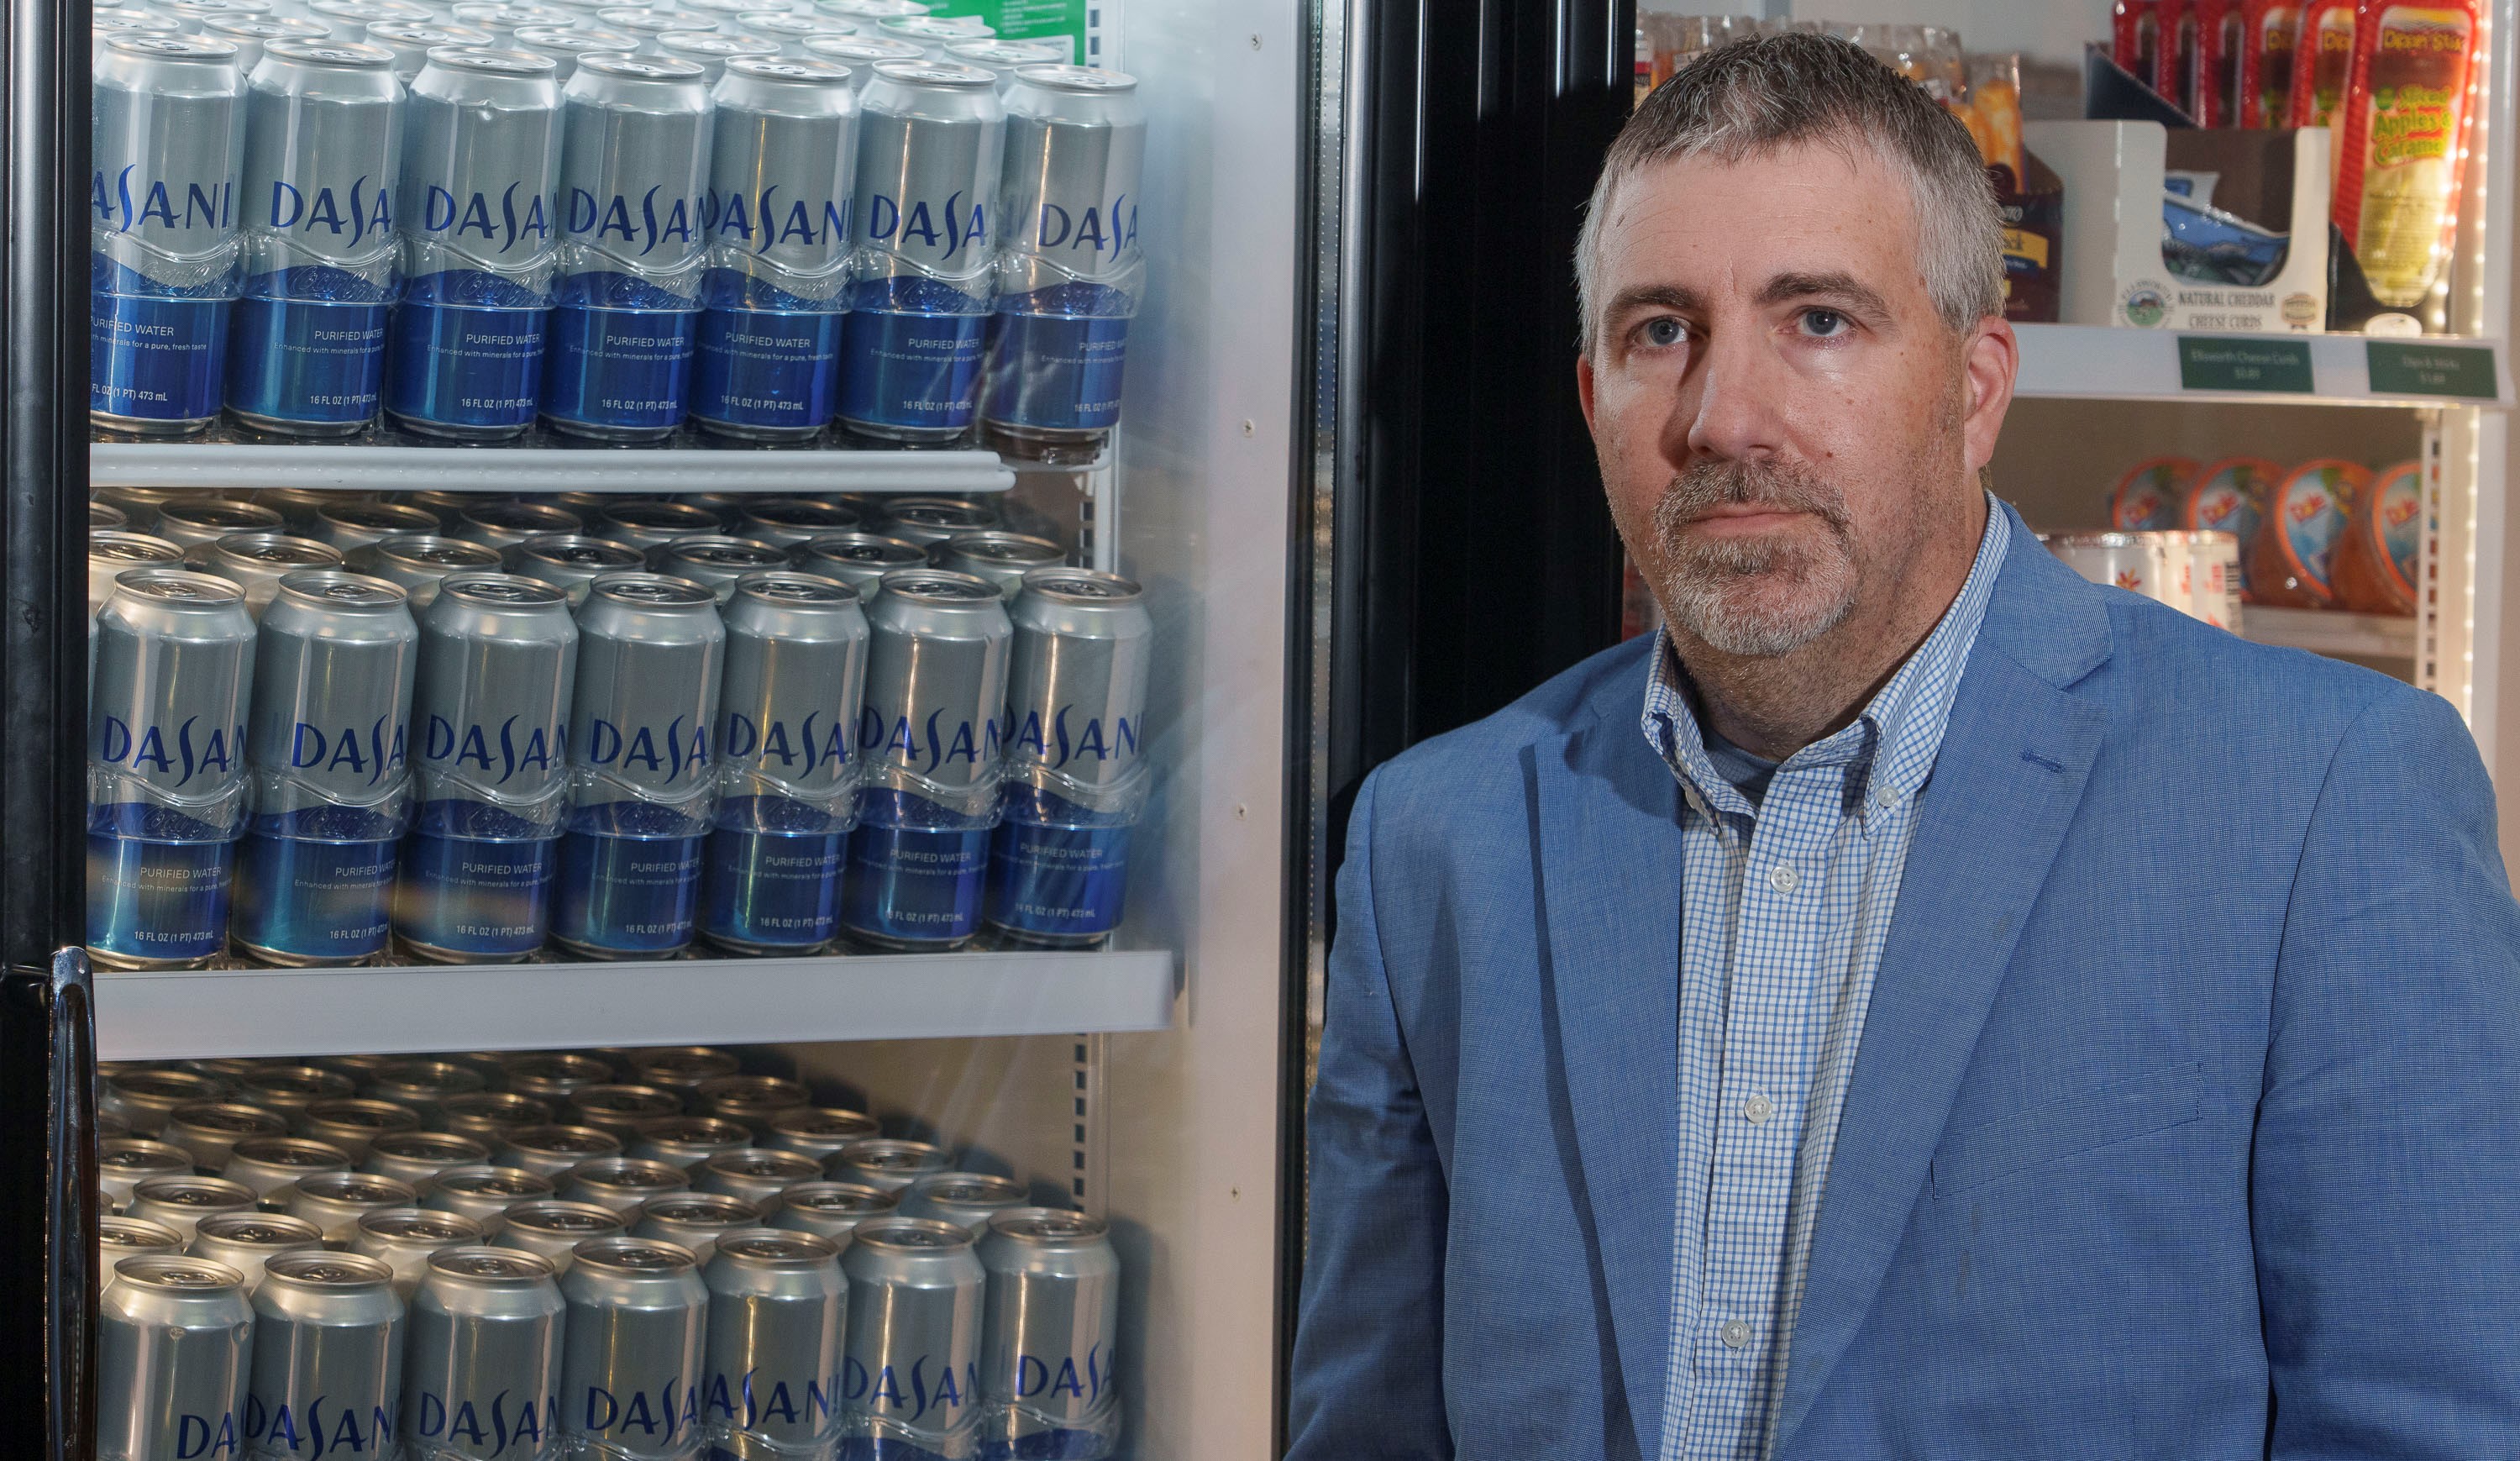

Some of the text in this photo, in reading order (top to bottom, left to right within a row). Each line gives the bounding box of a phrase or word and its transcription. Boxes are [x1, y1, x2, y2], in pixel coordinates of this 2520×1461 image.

[2375, 112, 2437, 136] Apples
[2178, 292, 2224, 307] NATURAL
[2228, 292, 2275, 308] CHEDDAR
[2189, 314, 2263, 329] CHEESE CURDS
[135, 324, 174, 336] WATER
[315, 331, 360, 340] PURIFIED
[466, 334, 512, 344] PURIFIED
[606, 336, 684, 346] PURIFIED WATER
[726, 332, 811, 348] PURIFIED WATER
[908, 339, 953, 349] PURIFIED
[275, 343, 311, 352] Enhanced
[428, 344, 462, 355] Enhanced
[739, 351, 770, 360] minerals
[92, 384, 167, 401] FL PT) 473 mL
[333, 397, 341, 405] OZ
[352, 396, 360, 405] PT)
[473, 399, 481, 407] FL
[485, 400, 494, 408] OZ
[505, 400, 514, 410] PT)
[602, 399, 611, 407] 16
[614, 400, 622, 408] FL
[625, 401, 634, 409] OZ
[646, 402, 656, 412] PT)
[732, 397, 739, 406] FL
[742, 398, 752, 407] OZ
[754, 399, 761, 410] (1
[764, 401, 776, 411] PT)
[778, 402, 791, 410] 473
[890, 849, 971, 863] PURIFIED WATER
[1021, 843, 1102, 858] PURIFIED WATER
[766, 856, 812, 867] PURIFIED
[140, 867, 222, 879] PURIFIED WATER
[336, 865, 377, 877] PURIFIED
[462, 862, 542, 875] PURIFIED WATER
[631, 863, 676, 872] PURIFIED
[295, 880, 331, 890] Enhanced
[761, 917, 769, 926] 16
[771, 918, 780, 927] FL
[907, 913, 916, 922] OZ
[351, 930, 360, 938] OZ
[457, 925, 525, 937] 16 FL OZ PT) 473
[637, 925, 645, 933] FL
[134, 931, 204, 943] 16 FL OZ (1 PT) 473
